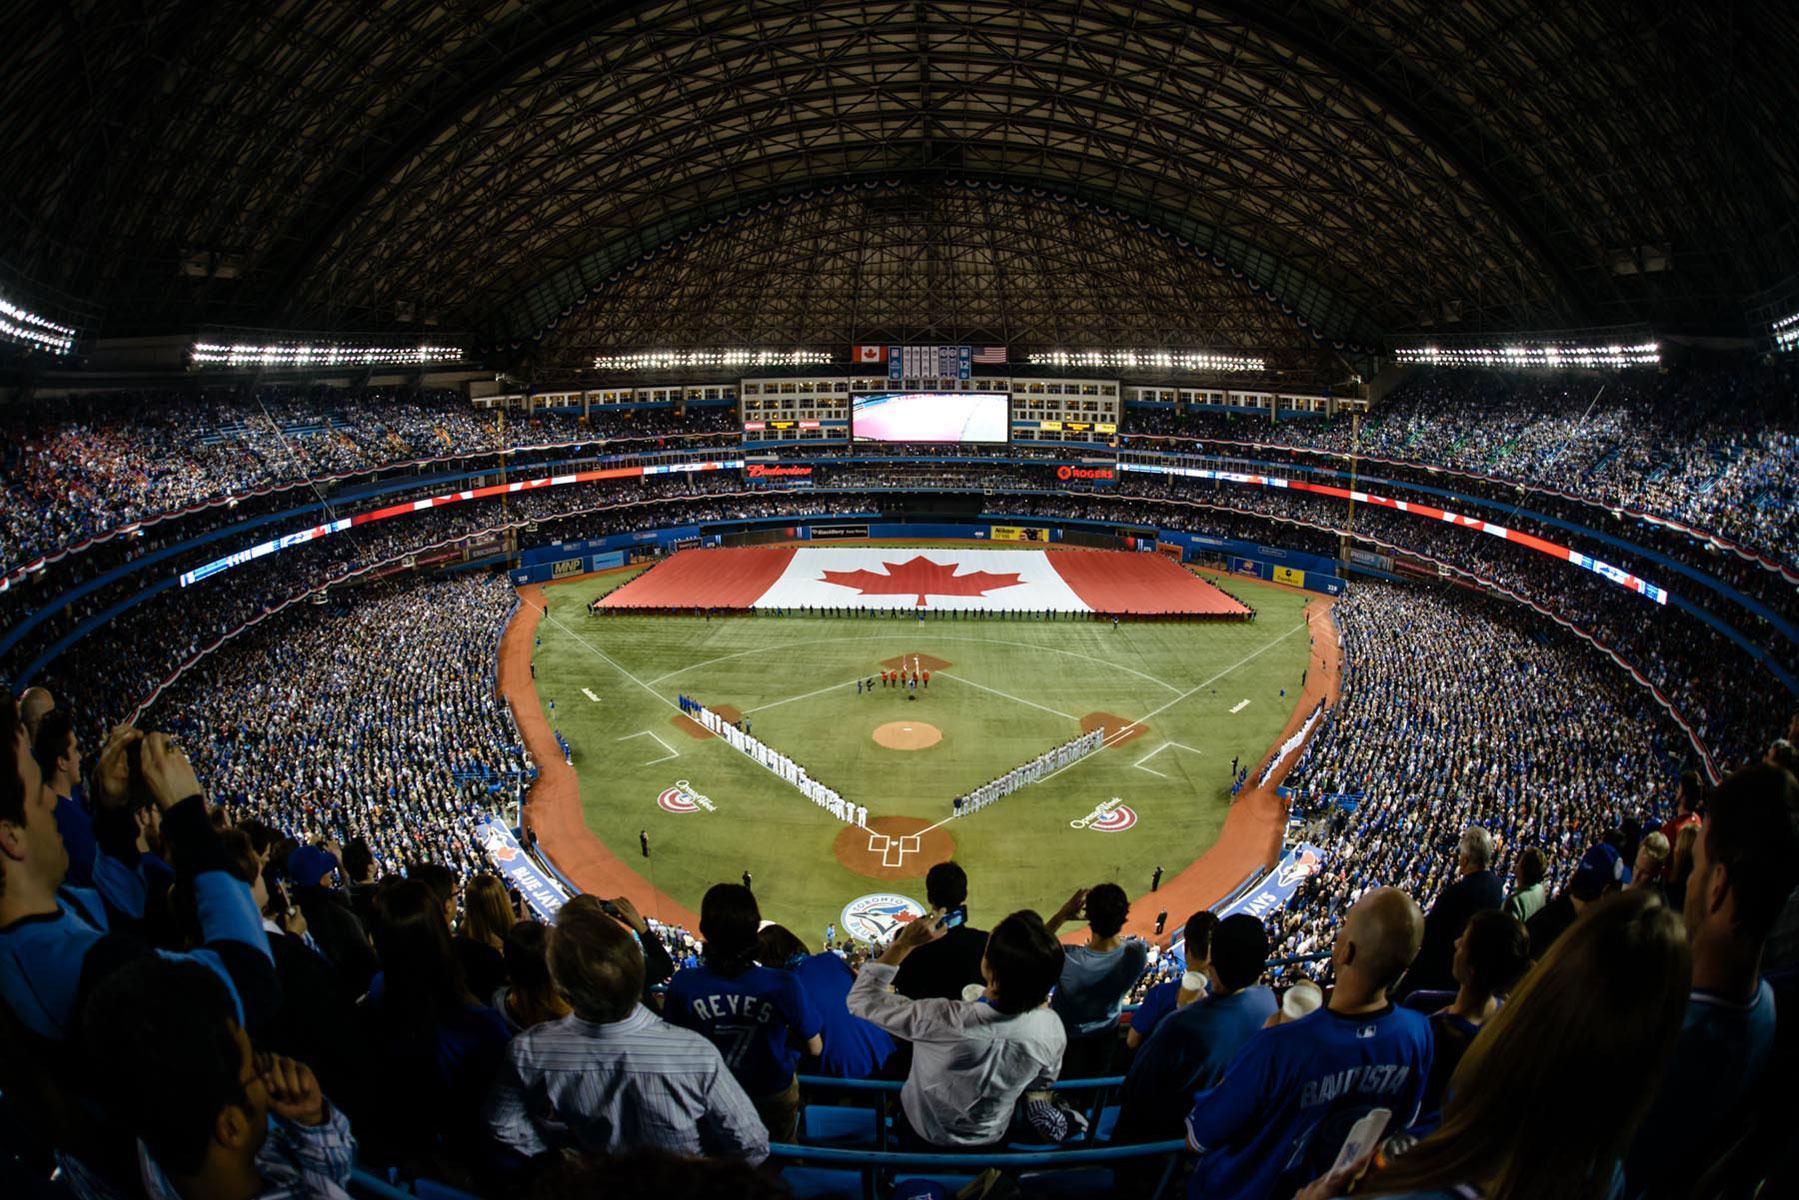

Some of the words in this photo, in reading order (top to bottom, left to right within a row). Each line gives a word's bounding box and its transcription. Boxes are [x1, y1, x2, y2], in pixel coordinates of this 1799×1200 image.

[747, 464, 812, 478] Budweiser
[1073, 469, 1113, 479] ROGERS
[554, 560, 580, 574] MNP
[511, 866, 543, 892] BLUE
[852, 897, 904, 912] TORONTO
[693, 995, 773, 1023] REYES
[713, 1024, 758, 1069] 7
